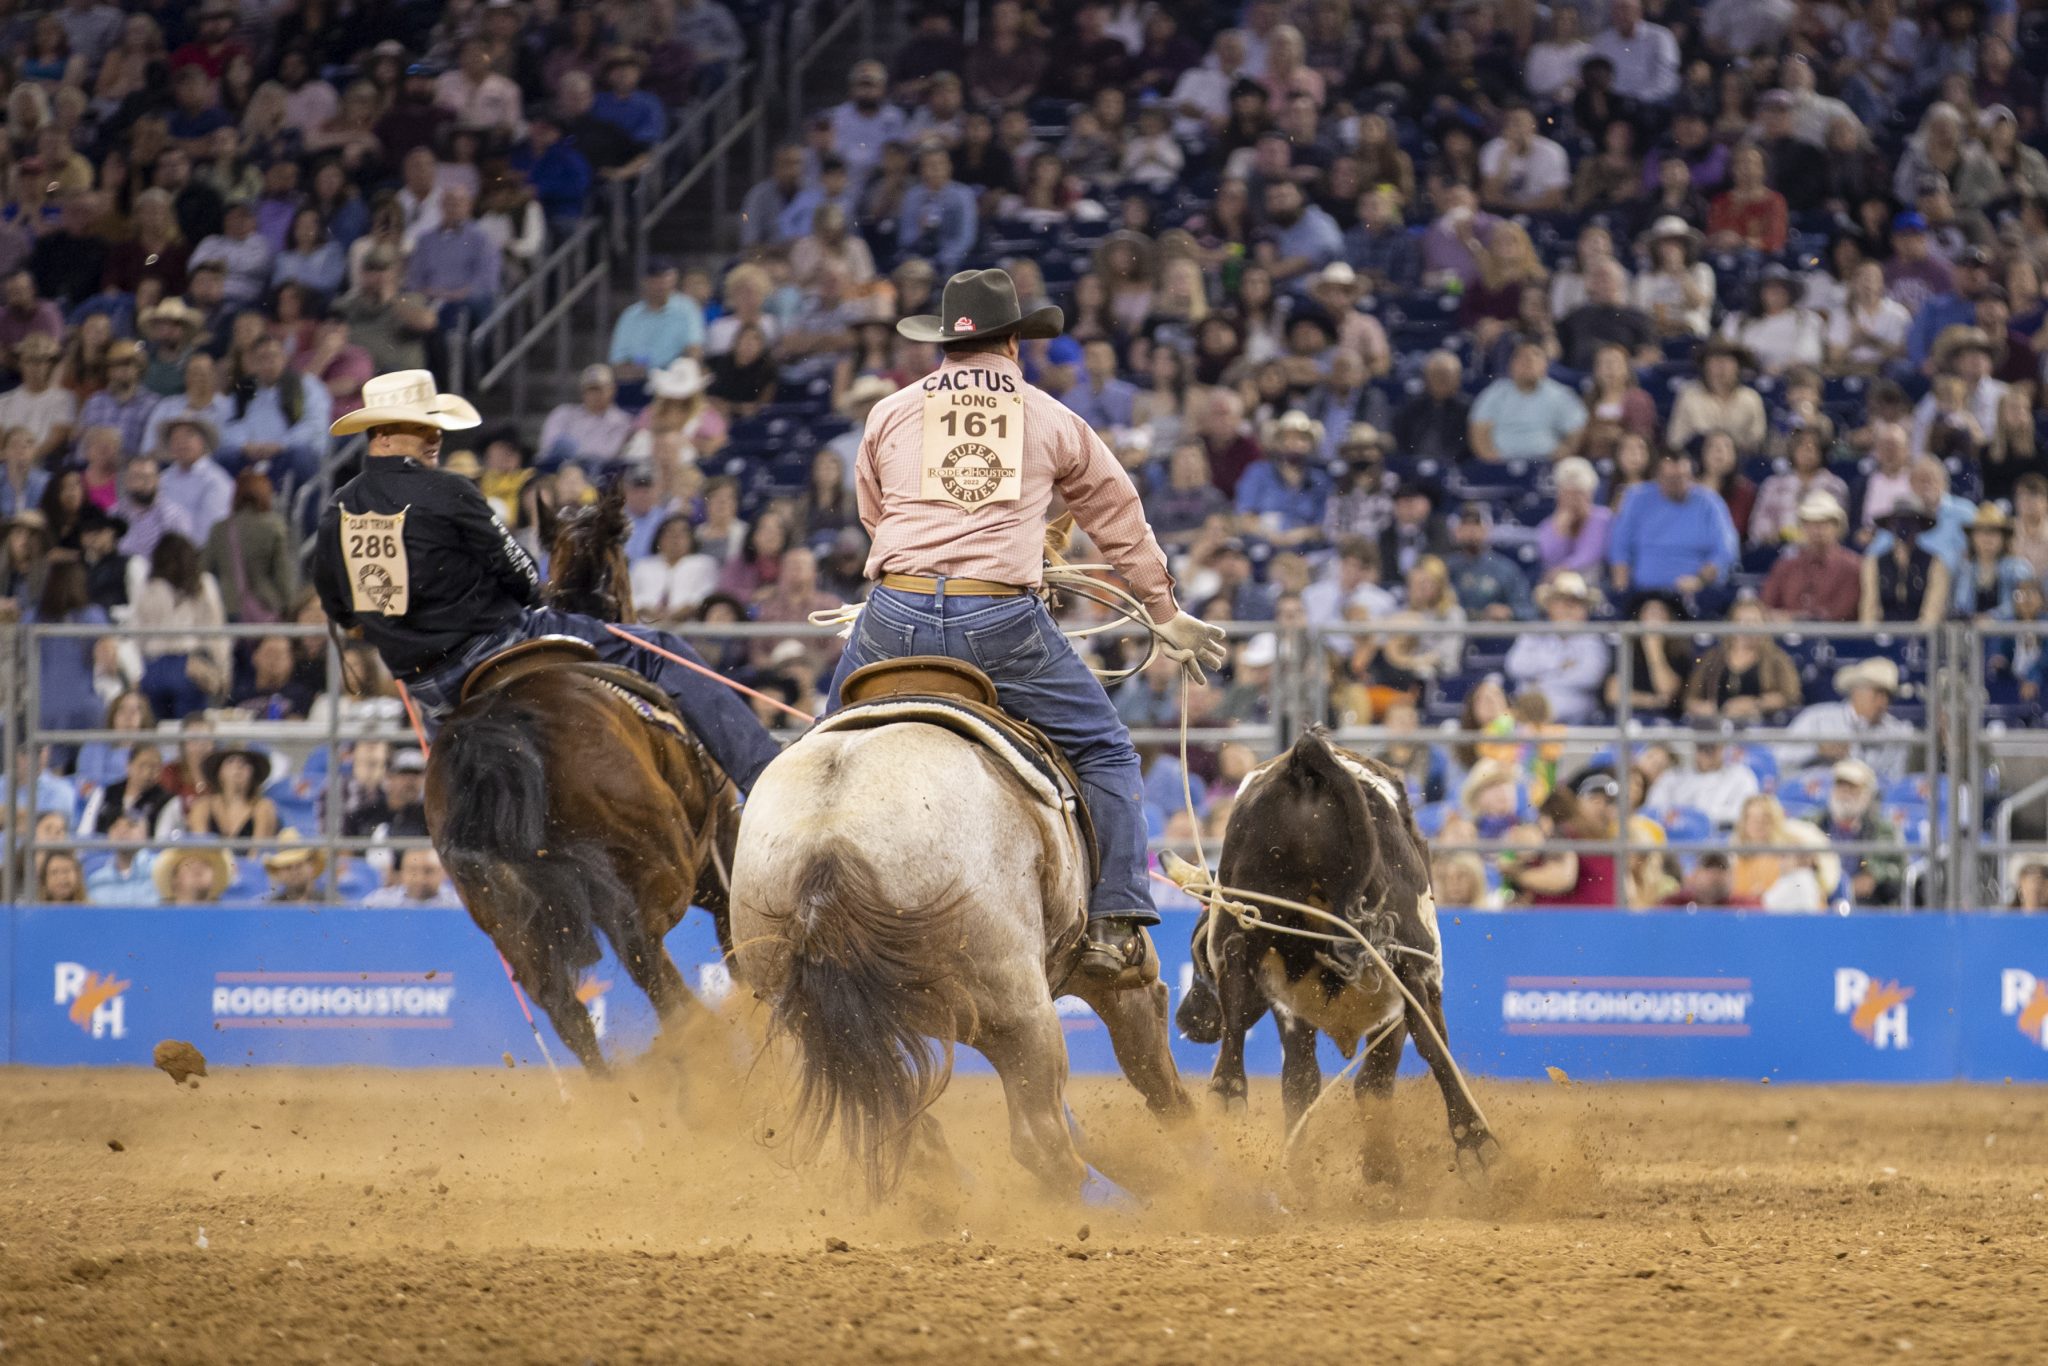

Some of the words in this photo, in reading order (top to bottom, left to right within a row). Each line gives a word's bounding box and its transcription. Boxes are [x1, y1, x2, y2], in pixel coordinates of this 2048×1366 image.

[922, 368, 1015, 393] CACTUS
[951, 394, 997, 408] LONG
[940, 410, 1007, 439] 161
[947, 444, 997, 464] SUPER
[945, 480, 997, 502] SERIES
[350, 519, 367, 530] CLAY
[350, 535, 397, 558] 286
[211, 986, 452, 1017] RODEOHOUSTON
[1503, 991, 1748, 1022] RODEOHOUSTON
